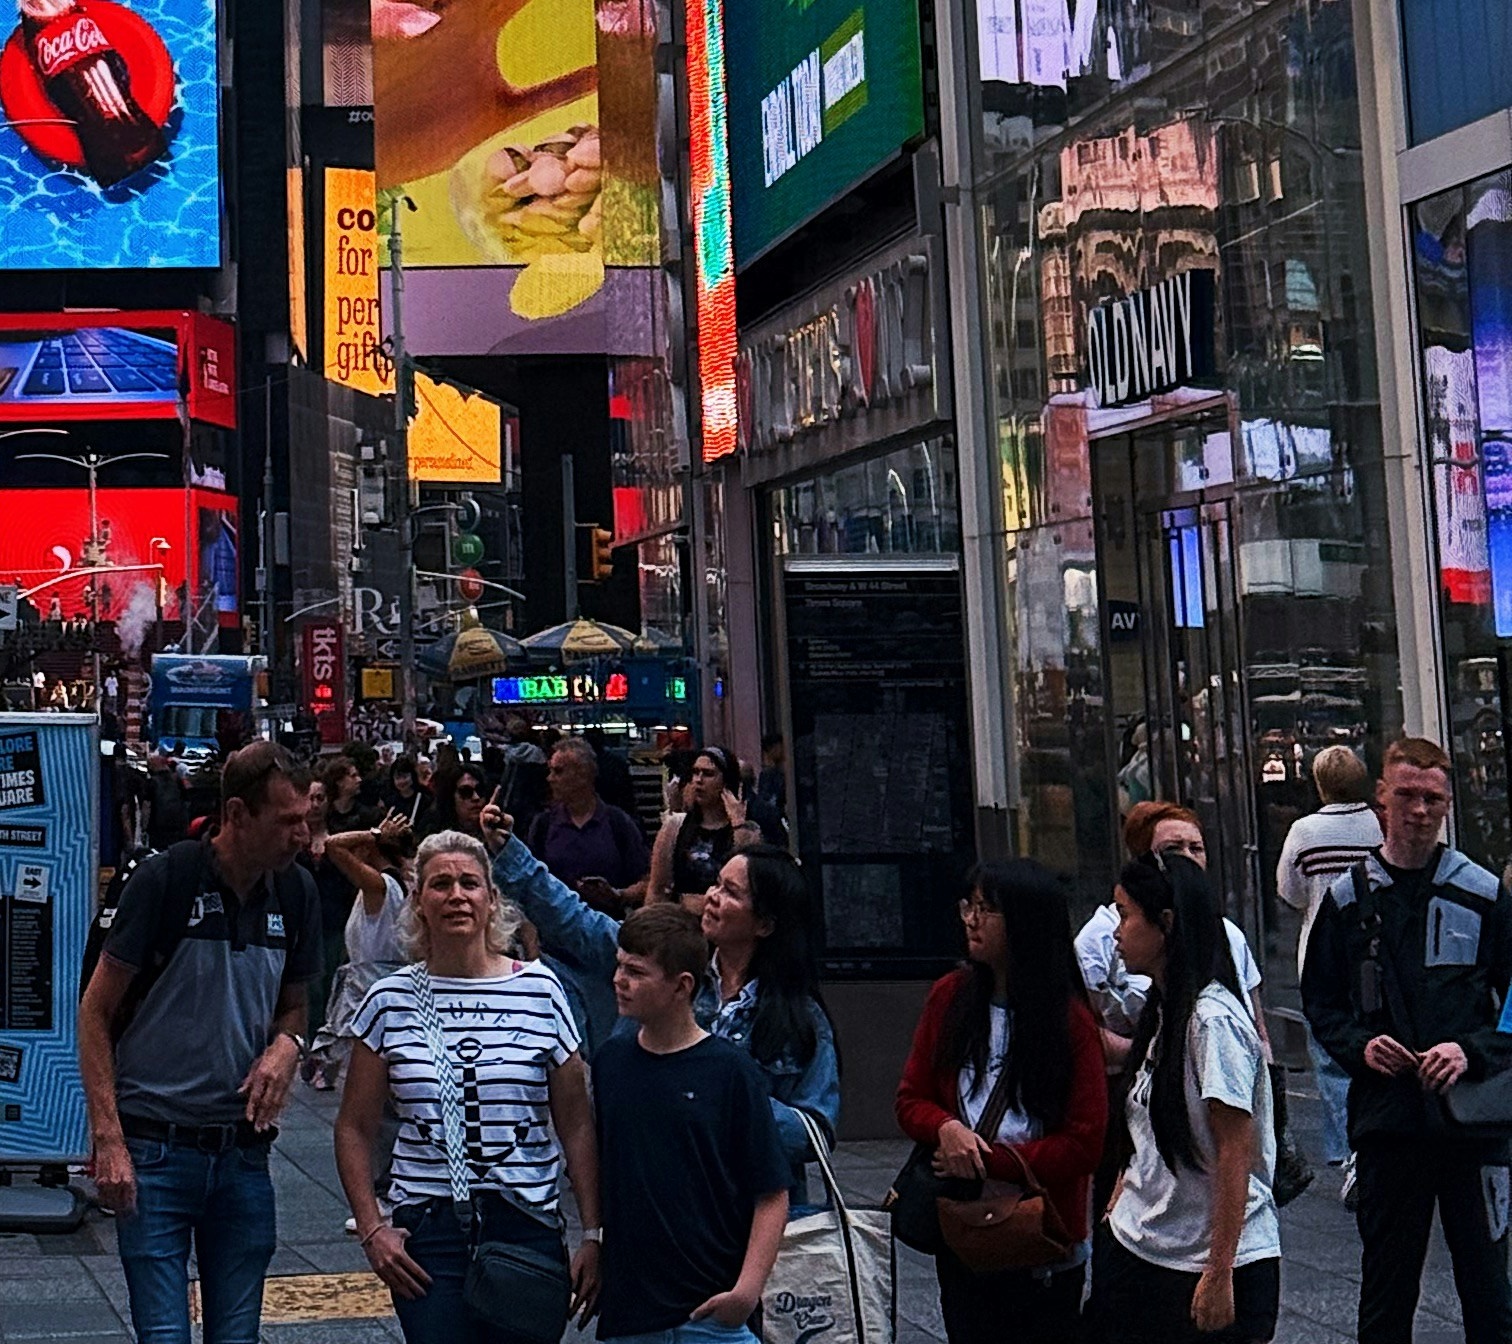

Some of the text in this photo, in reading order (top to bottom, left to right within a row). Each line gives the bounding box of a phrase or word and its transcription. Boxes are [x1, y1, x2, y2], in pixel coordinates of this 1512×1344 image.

[337, 235, 373, 276] for
[337, 295, 381, 335] per
[1090, 271, 1191, 408] OLD NAVY
[312, 627, 337, 680] tkts
[11, 830, 42, 842] STREET
